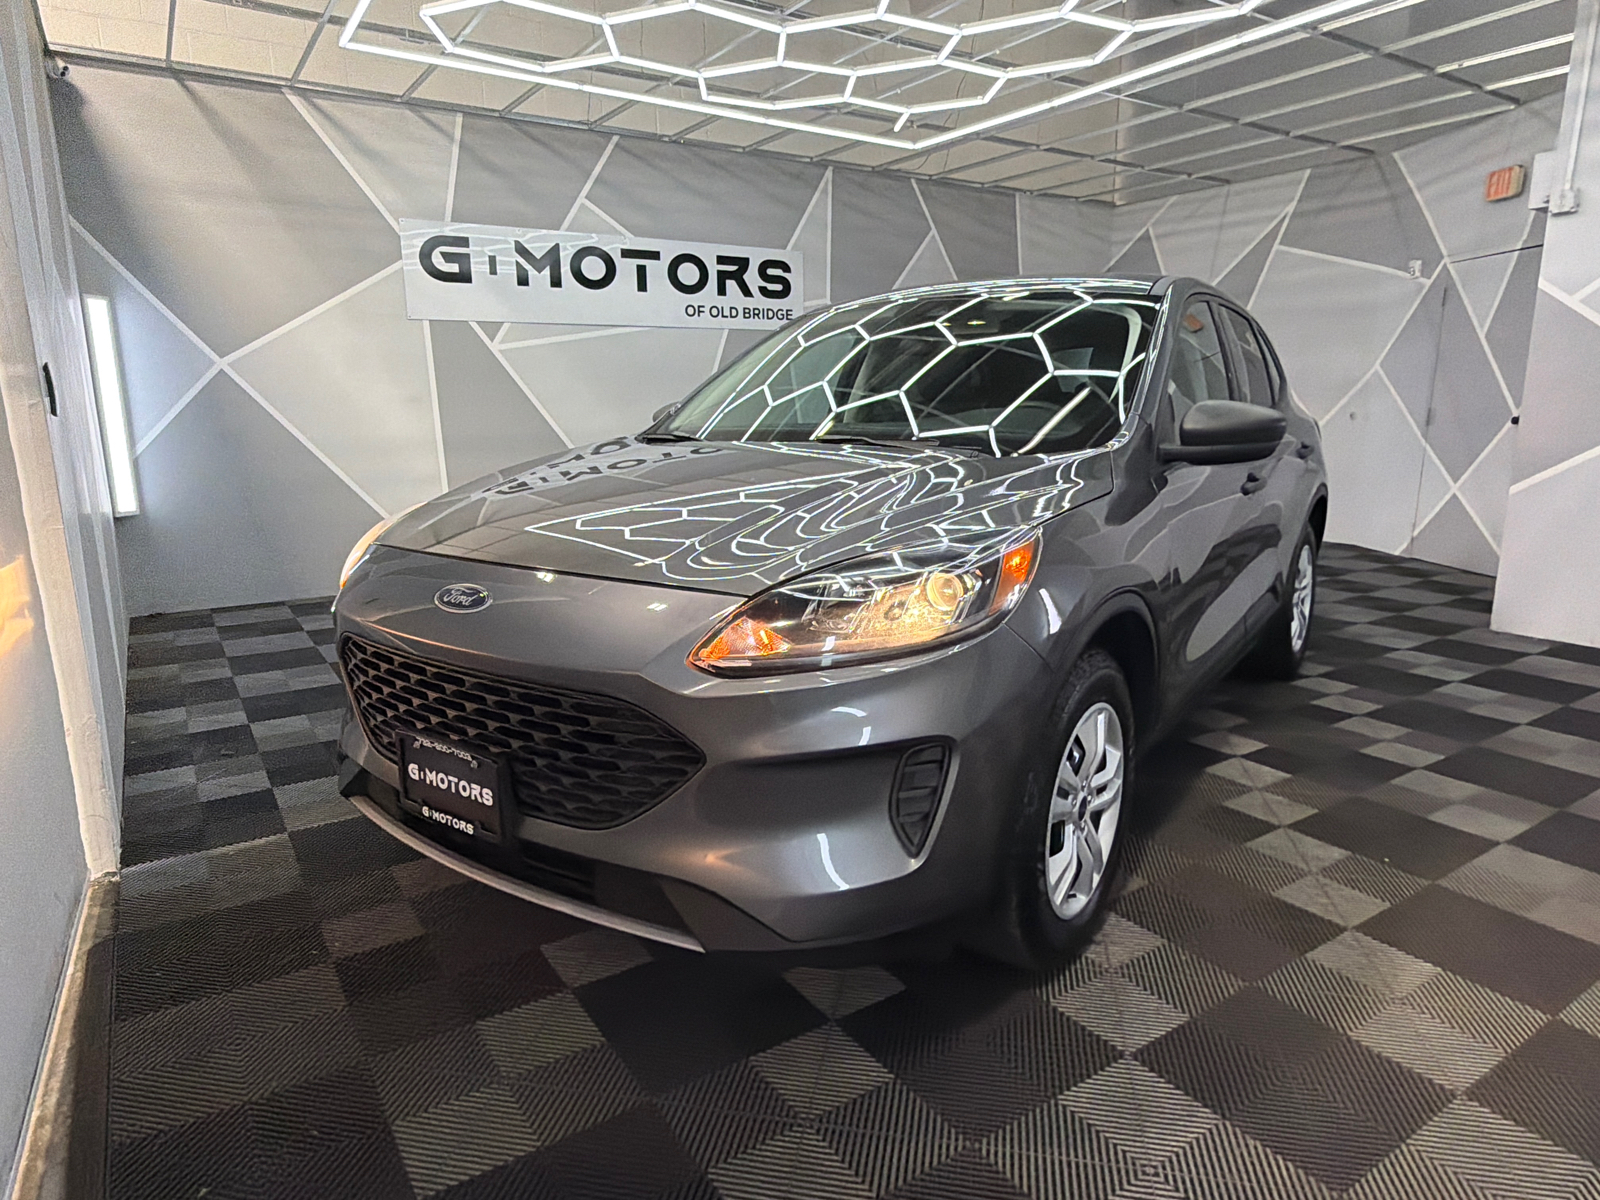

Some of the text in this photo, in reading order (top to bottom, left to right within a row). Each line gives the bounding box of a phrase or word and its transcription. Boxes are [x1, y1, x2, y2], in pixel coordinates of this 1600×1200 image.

[684, 304, 794, 321] OF OLD BRIDGE
[443, 587, 479, 606] Ford
